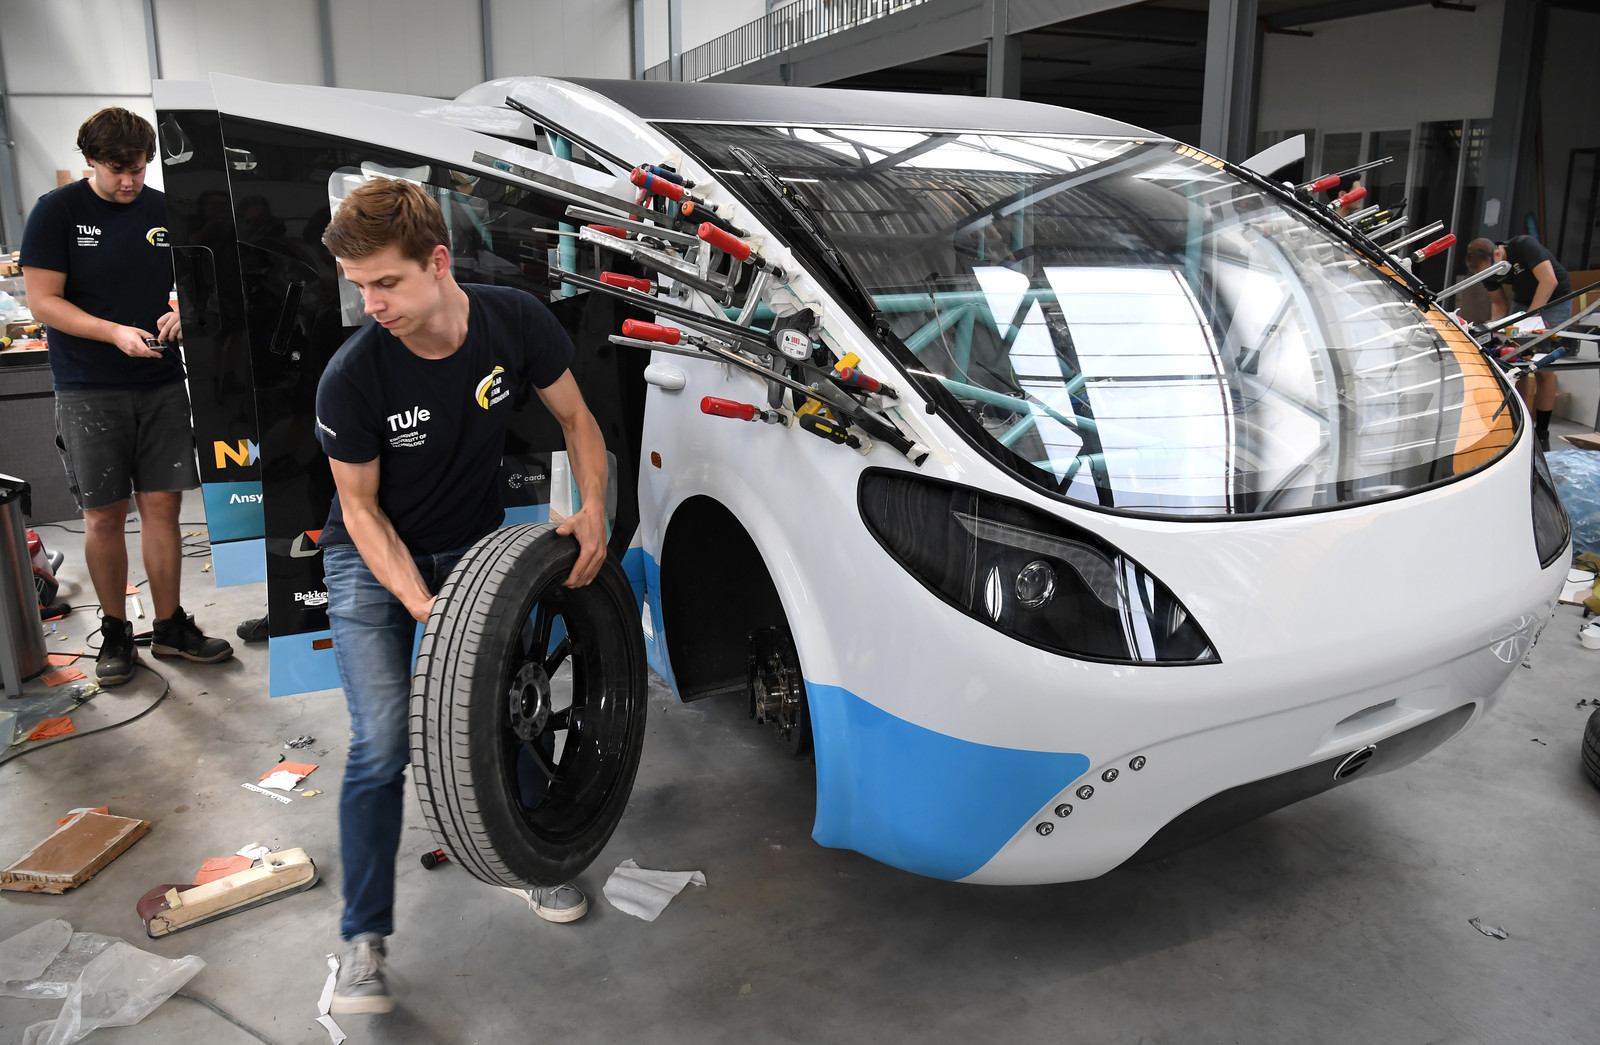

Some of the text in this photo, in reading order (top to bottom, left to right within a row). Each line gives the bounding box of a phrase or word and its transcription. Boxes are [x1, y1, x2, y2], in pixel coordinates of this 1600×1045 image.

[76, 225, 102, 236] TU/e
[387, 405, 431, 432] TU/e
[524, 473, 546, 482] cards
[229, 493, 263, 504] Ansy
